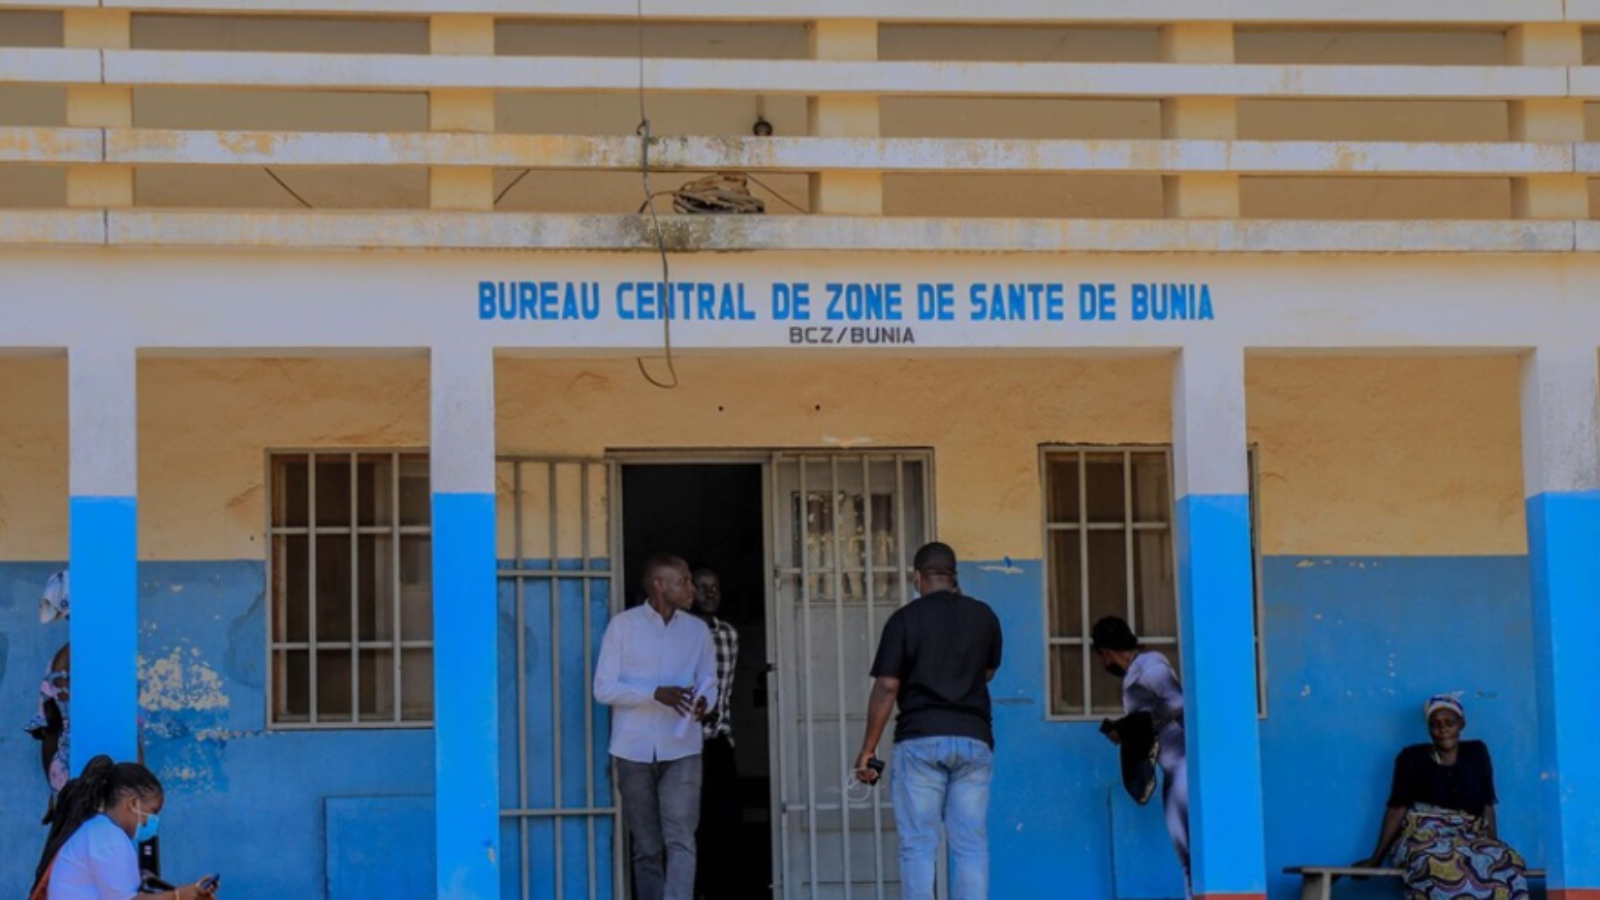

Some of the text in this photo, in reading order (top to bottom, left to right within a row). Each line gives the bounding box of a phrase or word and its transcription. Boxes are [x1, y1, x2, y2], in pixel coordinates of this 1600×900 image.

[479, 281, 1214, 322] BUREAU CENTRAL DE ZONE DE SANTE DE BUNIA
[789, 326, 916, 344] BCZ/BUNIA
